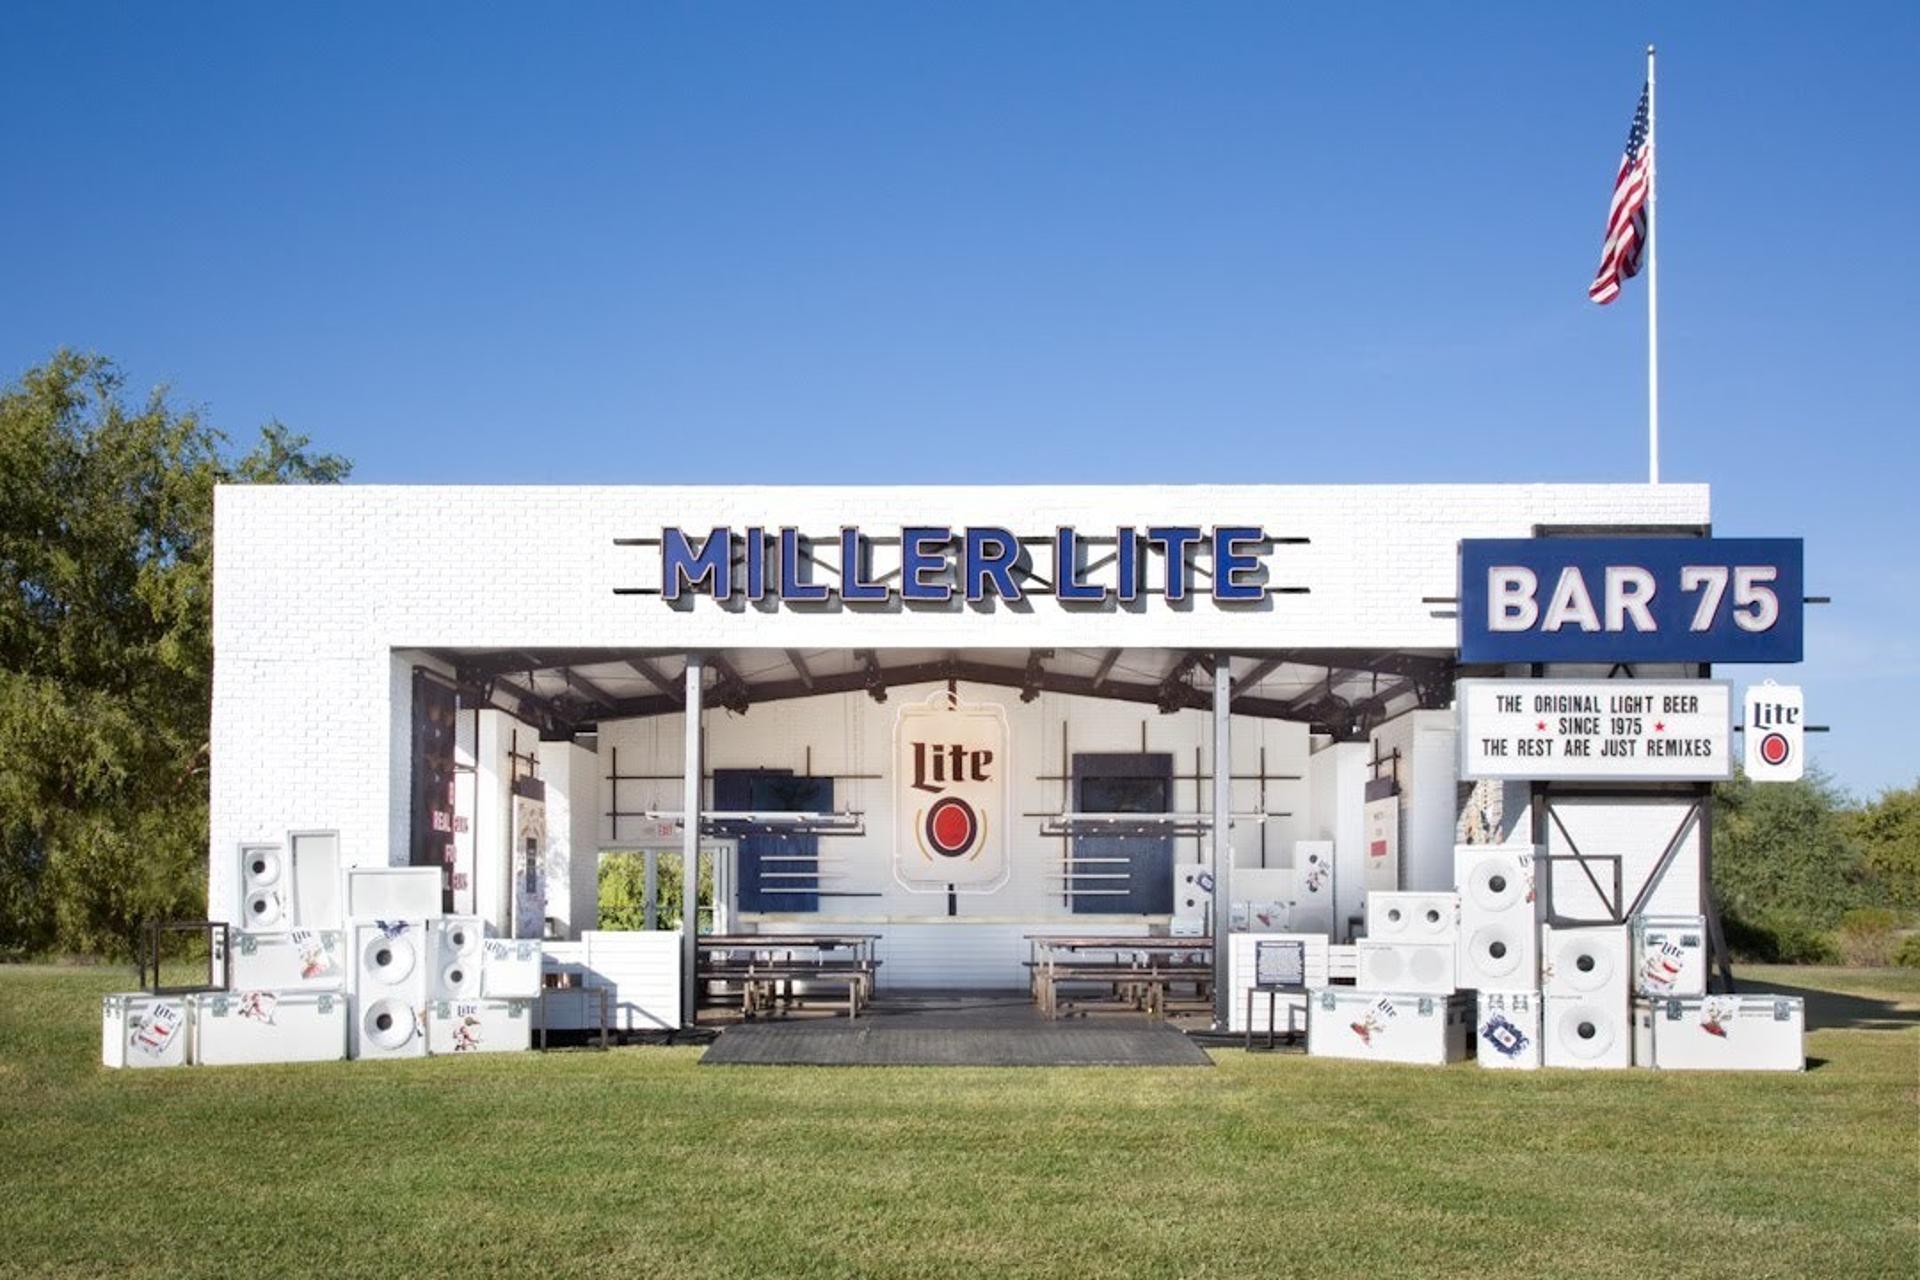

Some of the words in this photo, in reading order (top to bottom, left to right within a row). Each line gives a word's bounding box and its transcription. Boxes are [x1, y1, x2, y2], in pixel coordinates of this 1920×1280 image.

[661, 526, 1021, 600] MILLER
[1056, 526, 1265, 600] LITE
[1488, 566, 1658, 632] BAR
[1680, 566, 1779, 632] 75
[1496, 695, 1522, 714] THE
[1534, 695, 1601, 714] ORIGINAL
[1610, 695, 1654, 714] LIGHT
[1663, 695, 1699, 714] BEER
[1753, 702, 1799, 730] Lite
[1559, 717, 1600, 735] SINCE
[1611, 717, 1642, 735] 1975
[1482, 739, 1508, 757] THE
[1518, 739, 1553, 757] REST
[1564, 739, 1591, 757] ARE
[1601, 739, 1636, 757] JUST
[1647, 739, 1712, 757] REMIXES
[911, 742, 993, 794] Lite
[1661, 941, 1684, 959] Lite
[154, 1003, 177, 1021] Lite
